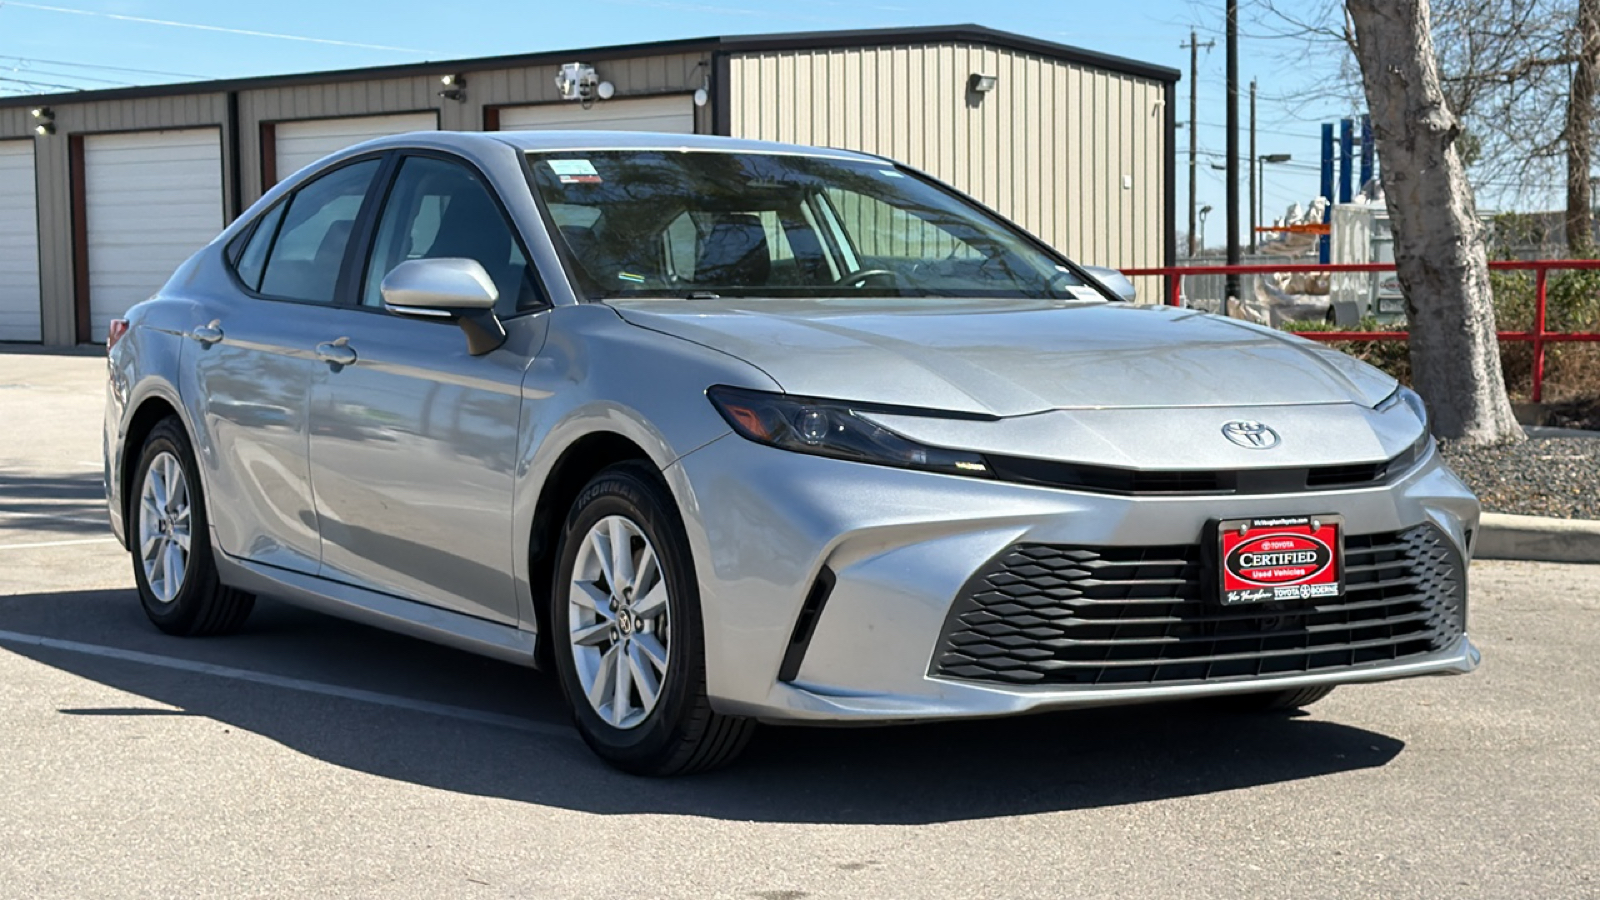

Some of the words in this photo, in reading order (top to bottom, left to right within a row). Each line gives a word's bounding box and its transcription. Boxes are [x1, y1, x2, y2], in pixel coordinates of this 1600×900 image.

[1270, 541, 1295, 549] TOYOTA
[1240, 551, 1317, 567] CERTIFIED
[1252, 570, 1272, 578] Used
[1274, 568, 1306, 577] Vehicles
[1274, 588, 1300, 598] TOYOTA
